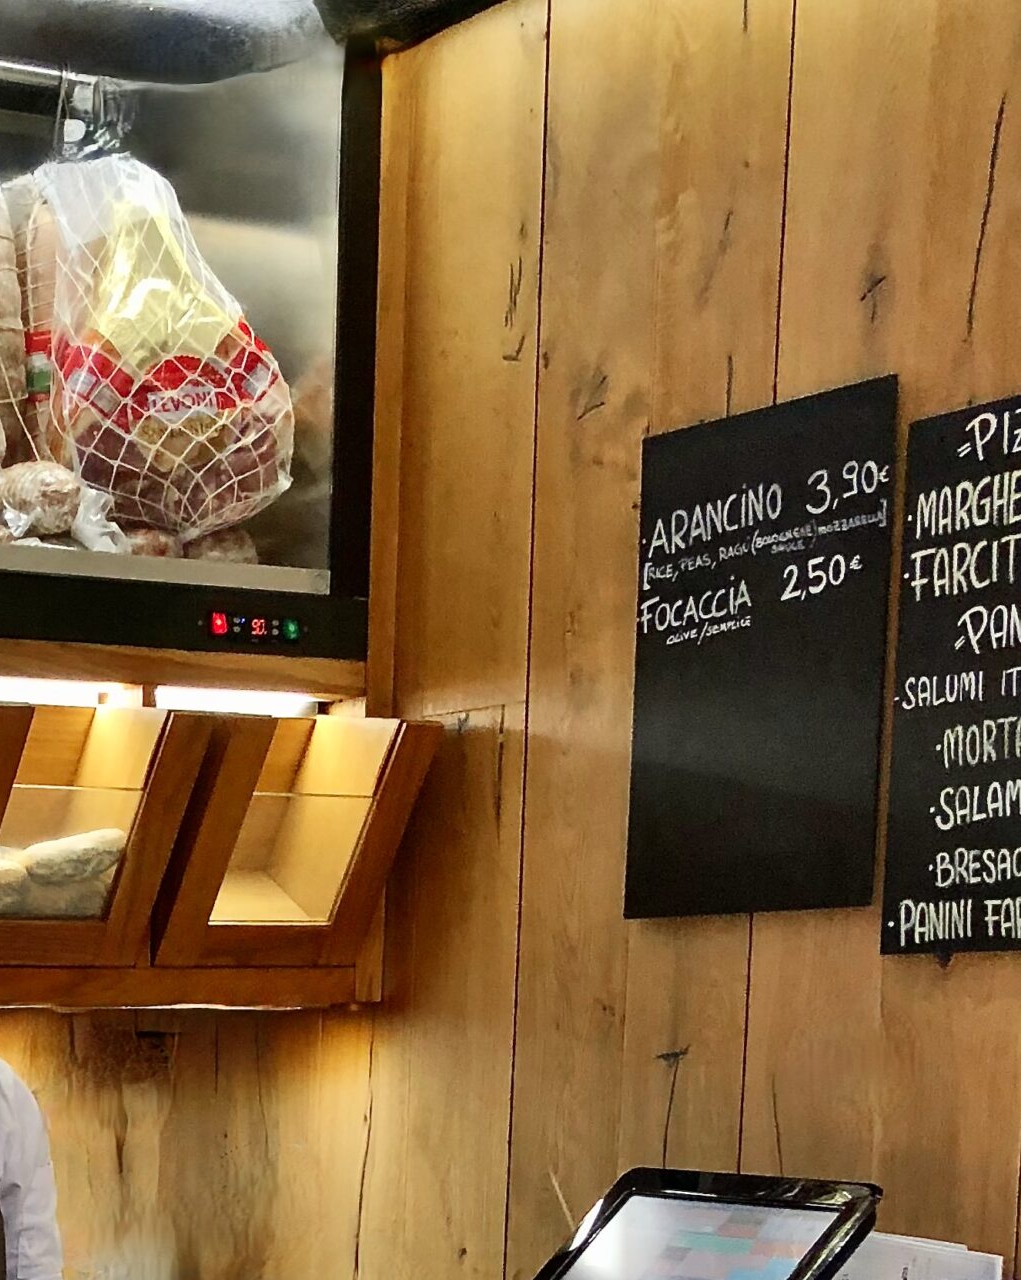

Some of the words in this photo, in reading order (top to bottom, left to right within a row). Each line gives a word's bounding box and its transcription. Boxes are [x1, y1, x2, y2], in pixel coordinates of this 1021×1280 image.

[910, 533, 1021, 602] FARCIT
[640, 576, 752, 634] FOCACCIA
[902, 671, 983, 710] SALUMI
[935, 779, 1021, 830] SALAM
[900, 898, 972, 947] PANINI
